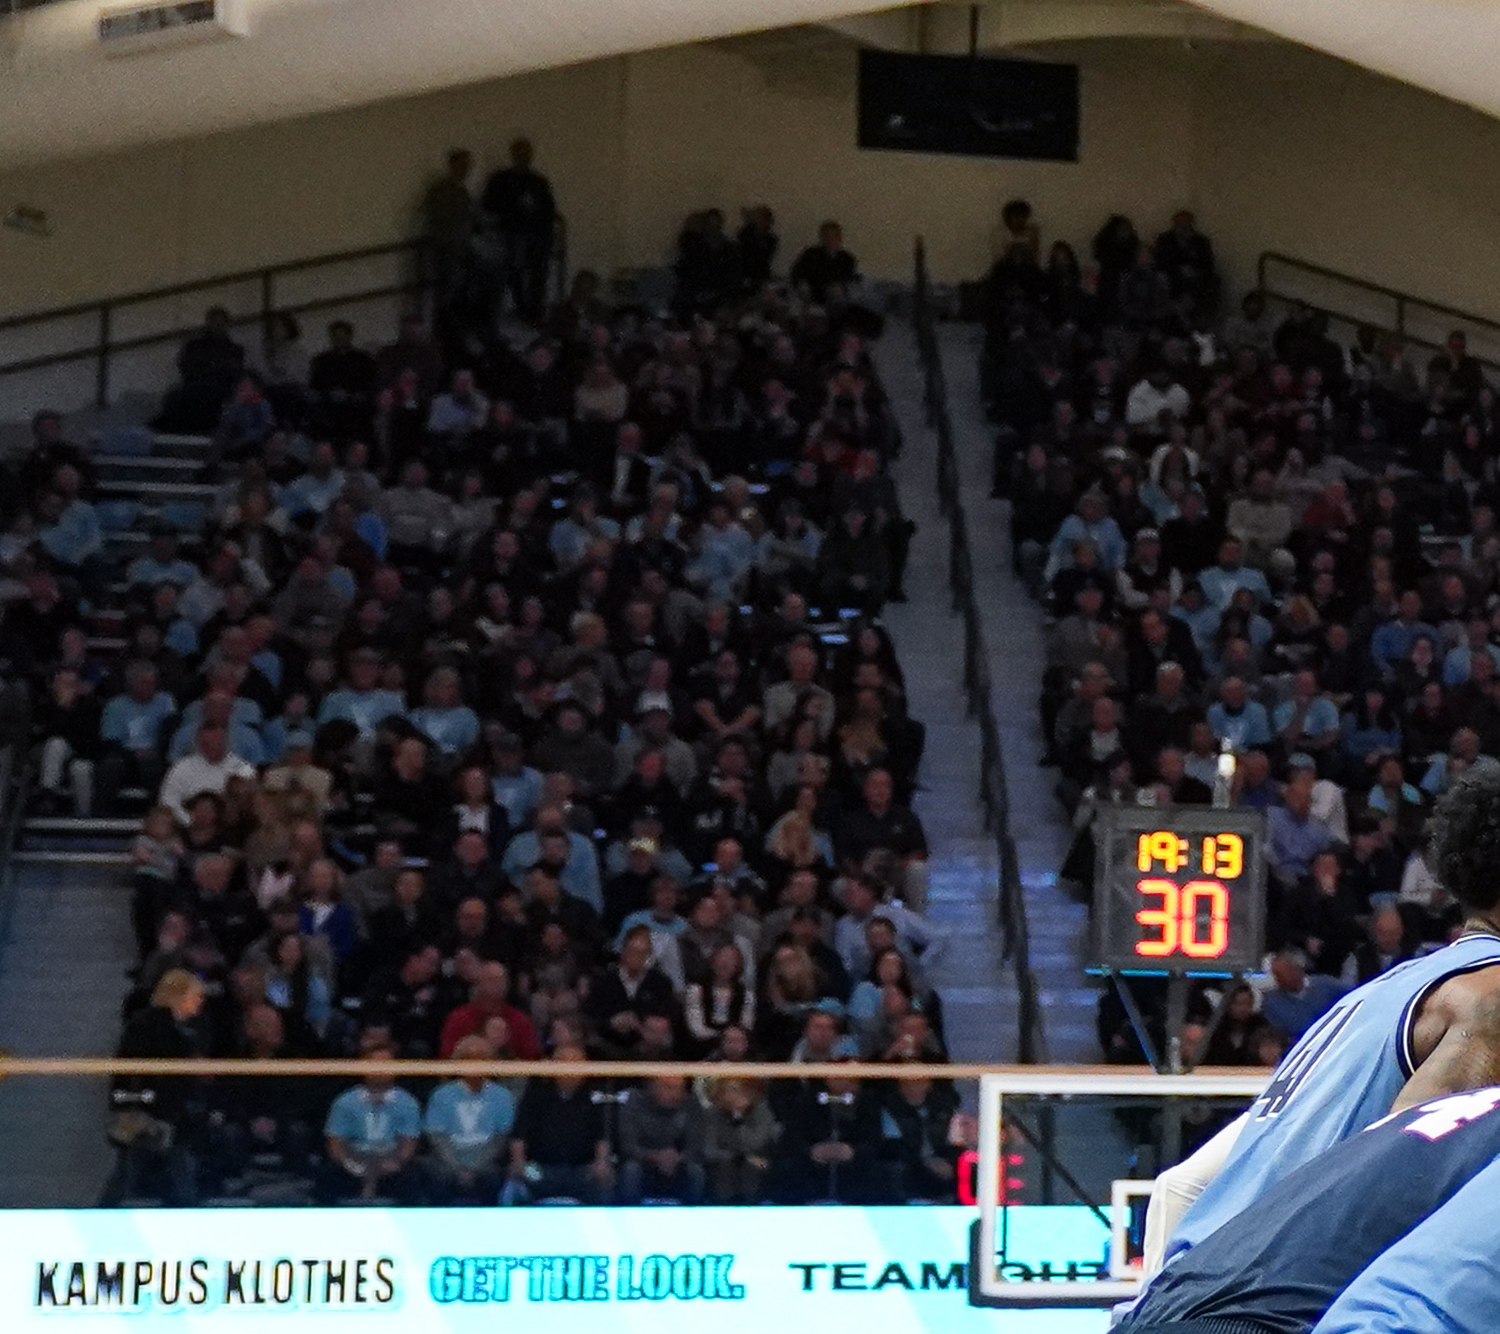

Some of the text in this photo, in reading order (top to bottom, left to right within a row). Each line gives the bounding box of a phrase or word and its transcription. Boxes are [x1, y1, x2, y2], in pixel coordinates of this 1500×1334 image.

[1138, 830, 1244, 879] 19:13
[1135, 878, 1230, 959] 30
[37, 1259, 394, 1306] KAMPUS KLOTHES
[430, 1254, 745, 1303] GET THE LOOK.
[789, 1262, 966, 1291] TEAM
